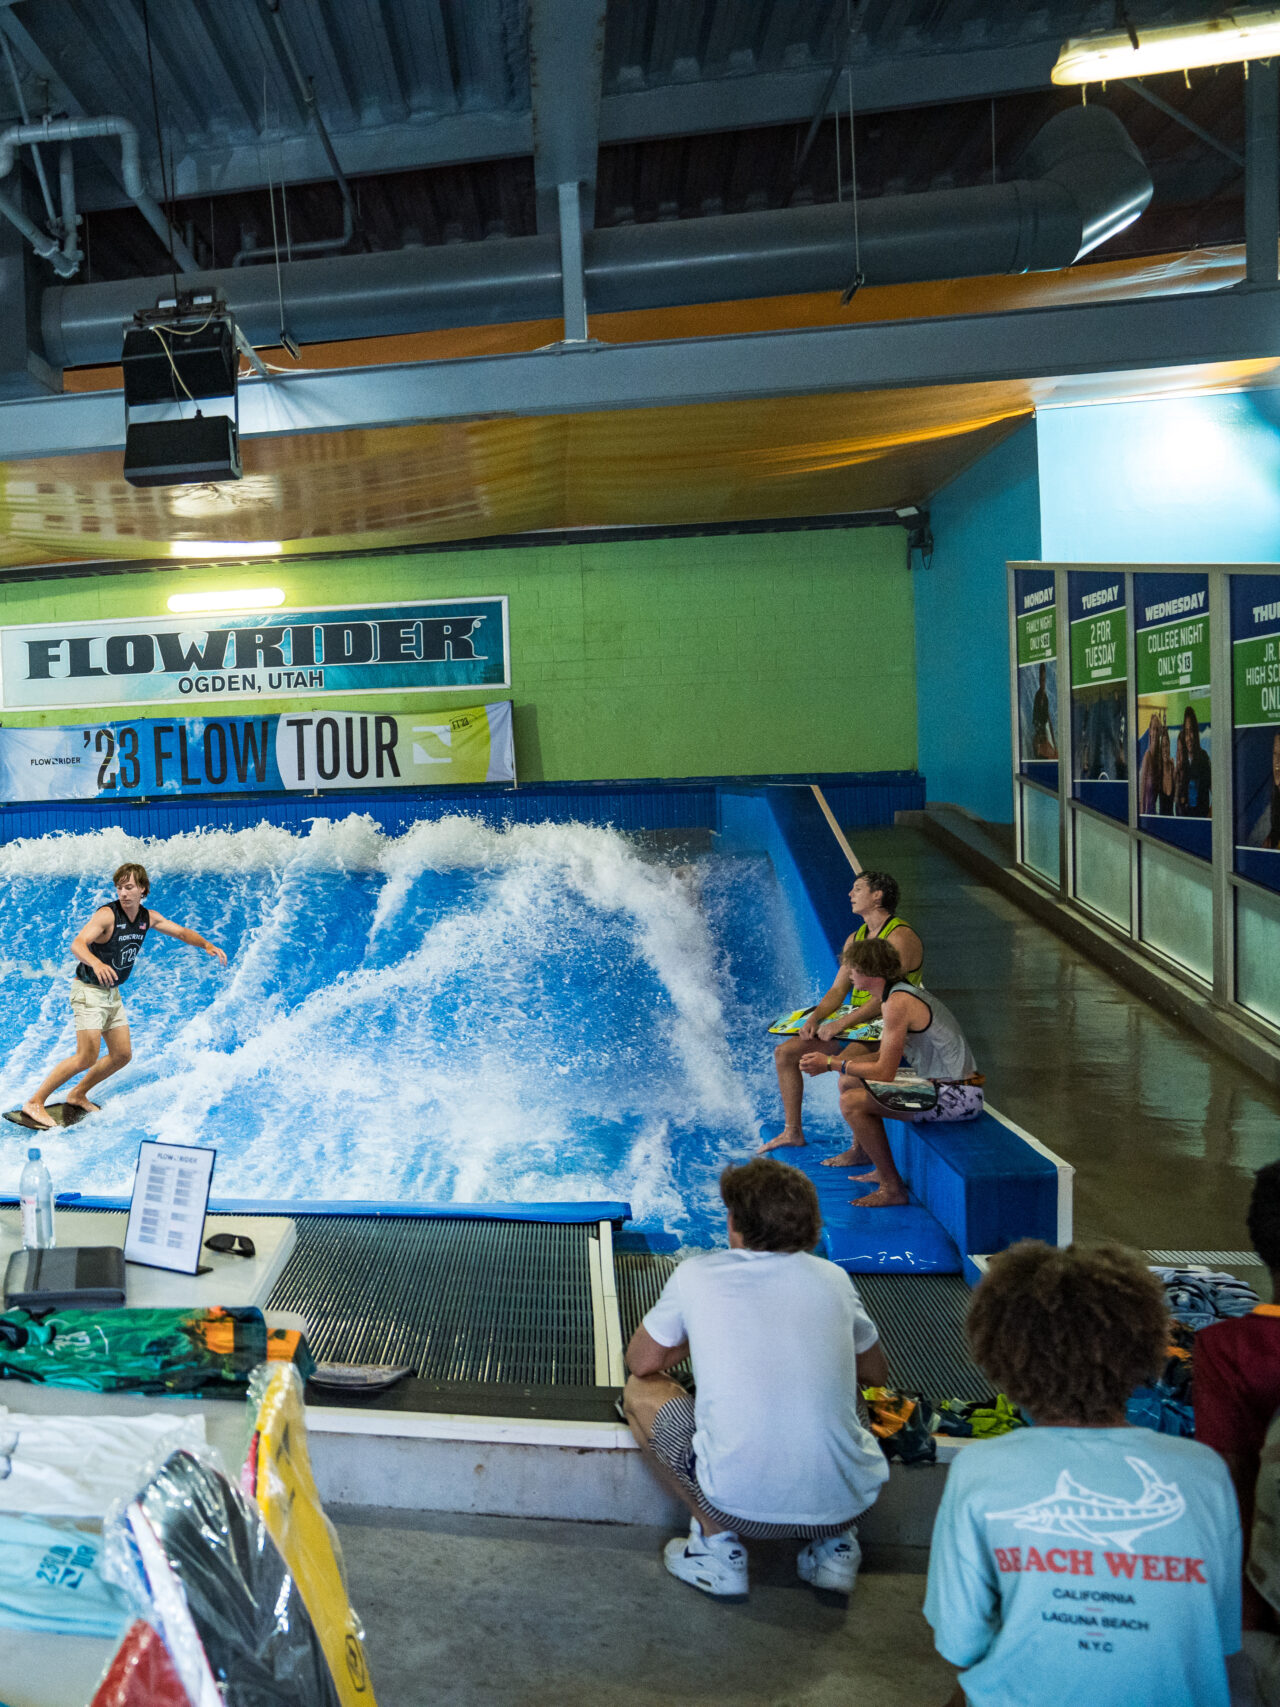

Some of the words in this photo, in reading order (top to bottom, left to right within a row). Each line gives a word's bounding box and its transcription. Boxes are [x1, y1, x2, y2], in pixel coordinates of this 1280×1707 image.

[1024, 587, 1053, 609] MONDAY
[1082, 585, 1119, 610] TUESDAY
[1145, 591, 1205, 621] WEDNESDAY
[1091, 624, 1095, 644] 2
[1097, 620, 1111, 643] FOR
[1148, 629, 1179, 653] COLLEGE
[1180, 623, 1203, 646] NIGHT
[23, 615, 487, 680] FLOWRIDER
[1085, 642, 1116, 668] TUESDAY
[1263, 643, 1277, 662] JR.
[1158, 655, 1177, 676] ONLY
[1246, 665, 1266, 686] HIGH
[1268, 663, 1280, 683] SC
[179, 673, 262, 694] OGDEN,
[269, 670, 324, 690] UTAH
[84, 728, 141, 789] '23
[153, 721, 269, 786] FLOW
[287, 716, 401, 780] TOUR
[993, 1546, 1095, 1576] BEACH
[1103, 1551, 1208, 1584] WEEK
[1052, 1588, 1136, 1605] CALIFORNIA
[1041, 1611, 1099, 1627] LAGUNA
[1101, 1615, 1150, 1631] BEACH
